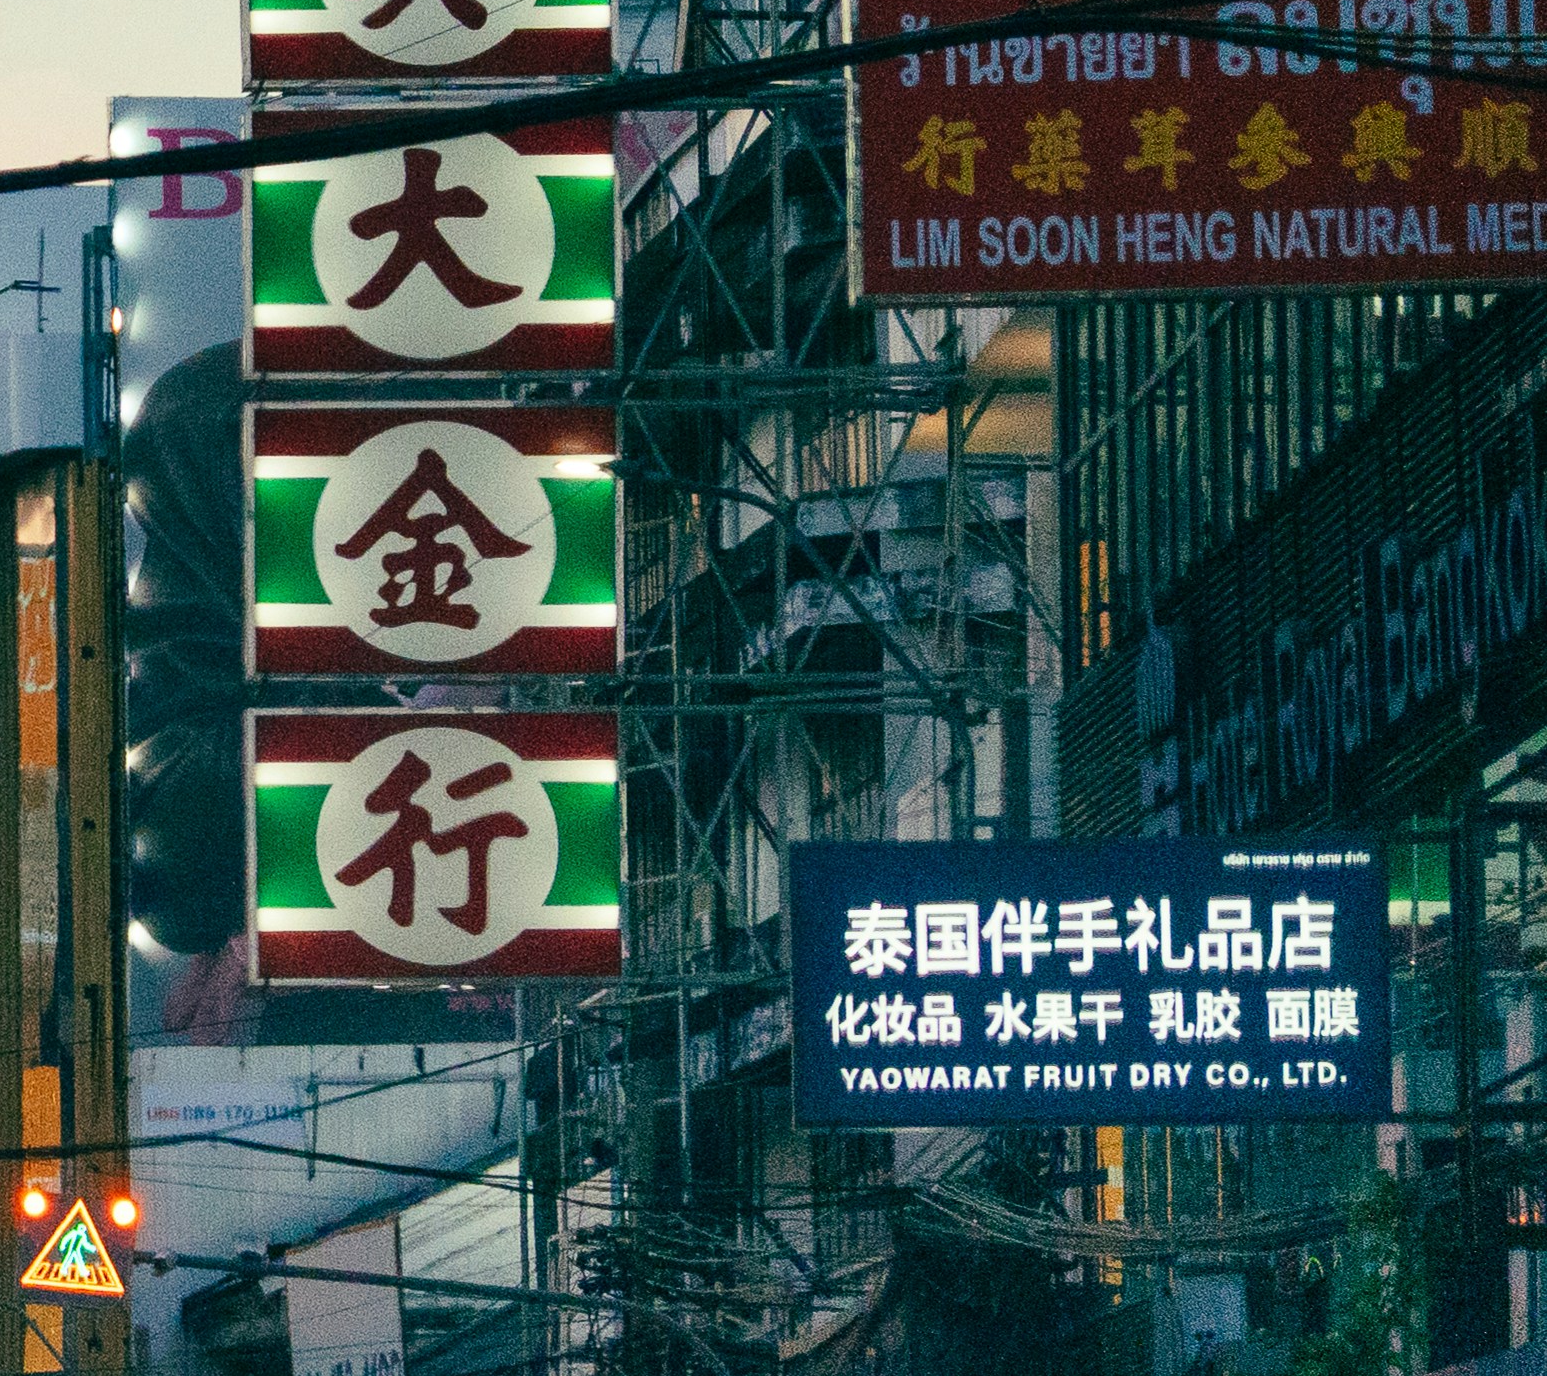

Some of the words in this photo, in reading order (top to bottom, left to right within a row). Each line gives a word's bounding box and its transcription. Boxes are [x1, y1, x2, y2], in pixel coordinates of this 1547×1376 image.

[890, 218, 962, 270] LIM
[978, 216, 1099, 268] SOON
[1115, 212, 1237, 264] HENG
[1253, 204, 1453, 259] NATURAL
[844, 893, 1335, 977] 泰国伴手礼品店
[824, 992, 962, 1045] 化妆品
[984, 991, 1124, 1044] 水果干
[1148, 989, 1242, 1042] 乳胶
[1266, 987, 1361, 1041] 面膜
[840, 1064, 1011, 1092] YAOWARAT
[1023, 1063, 1118, 1090] FRUIT
[1130, 1063, 1192, 1089] DRY
[1206, 1062, 1269, 1090] CO.,
[1282, 1061, 1348, 1086] LTD.
